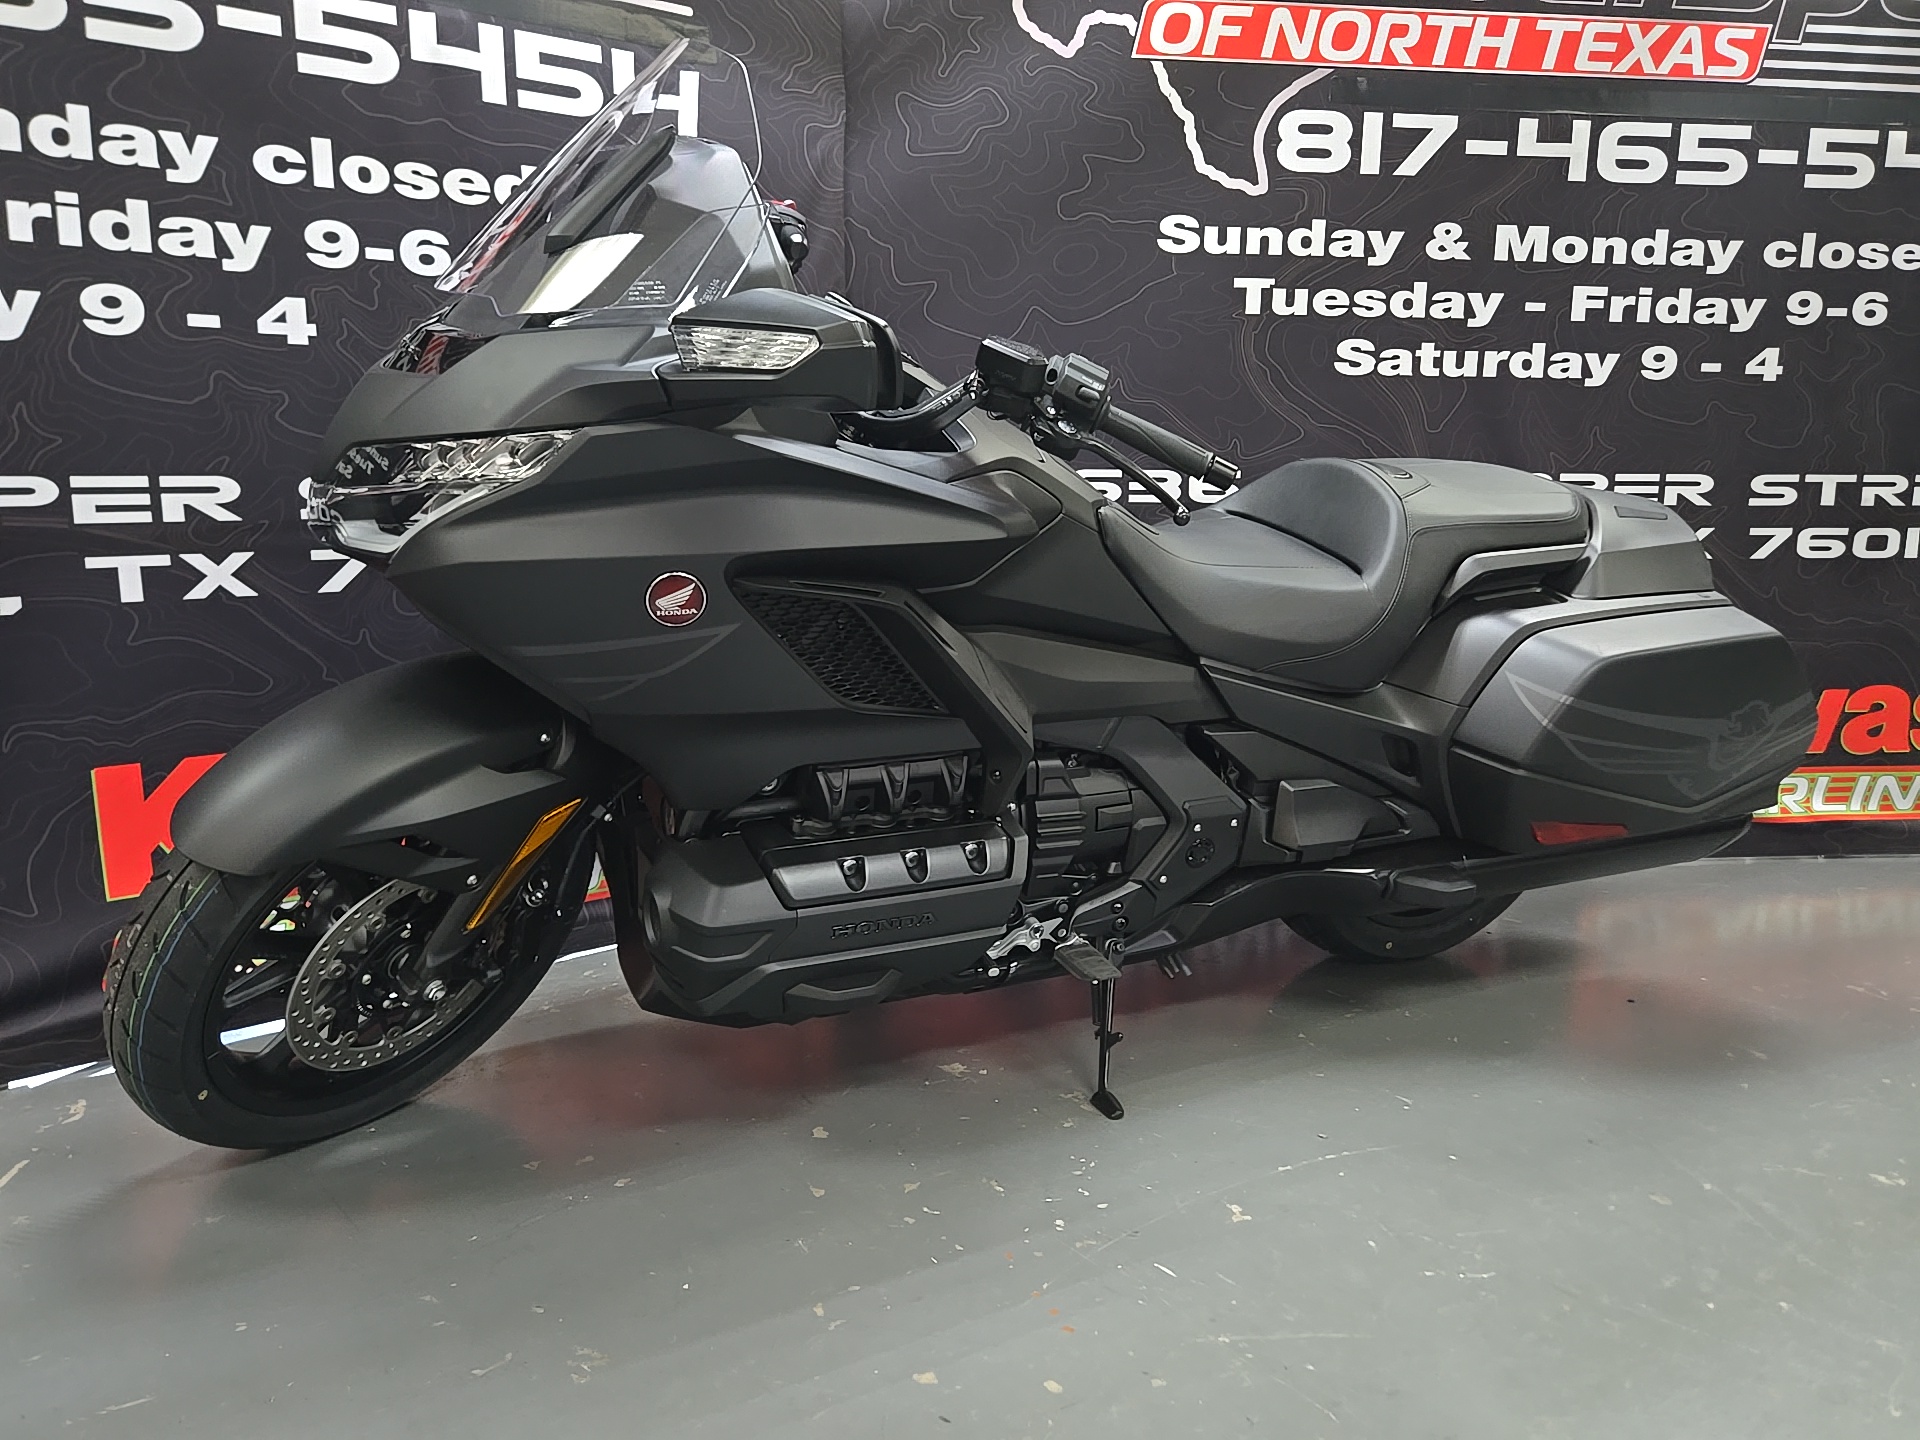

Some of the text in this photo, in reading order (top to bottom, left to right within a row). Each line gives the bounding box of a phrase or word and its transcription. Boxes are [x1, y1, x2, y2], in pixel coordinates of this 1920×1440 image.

[1149, 2, 1254, 56] OF
[1260, 7, 1519, 68] NORTH
[1535, 19, 1756, 77] TEXAS
[303, 219, 452, 277] 9-6
[1156, 214, 1920, 275] Sunday & Monday close
[79, 283, 146, 336] 9
[256, 296, 318, 346] 4
[1233, 277, 1505, 328] Tuesday
[1570, 285, 1768, 333] Friday
[1785, 290, 1889, 327] 9-6
[1333, 338, 1621, 387] Saturday
[1640, 345, 1678, 381] 9
[1744, 347, 1784, 382] 4
[84, 551, 259, 604] TX
[656, 608, 699, 617] HONDA
[831, 912, 937, 939] HONDA
